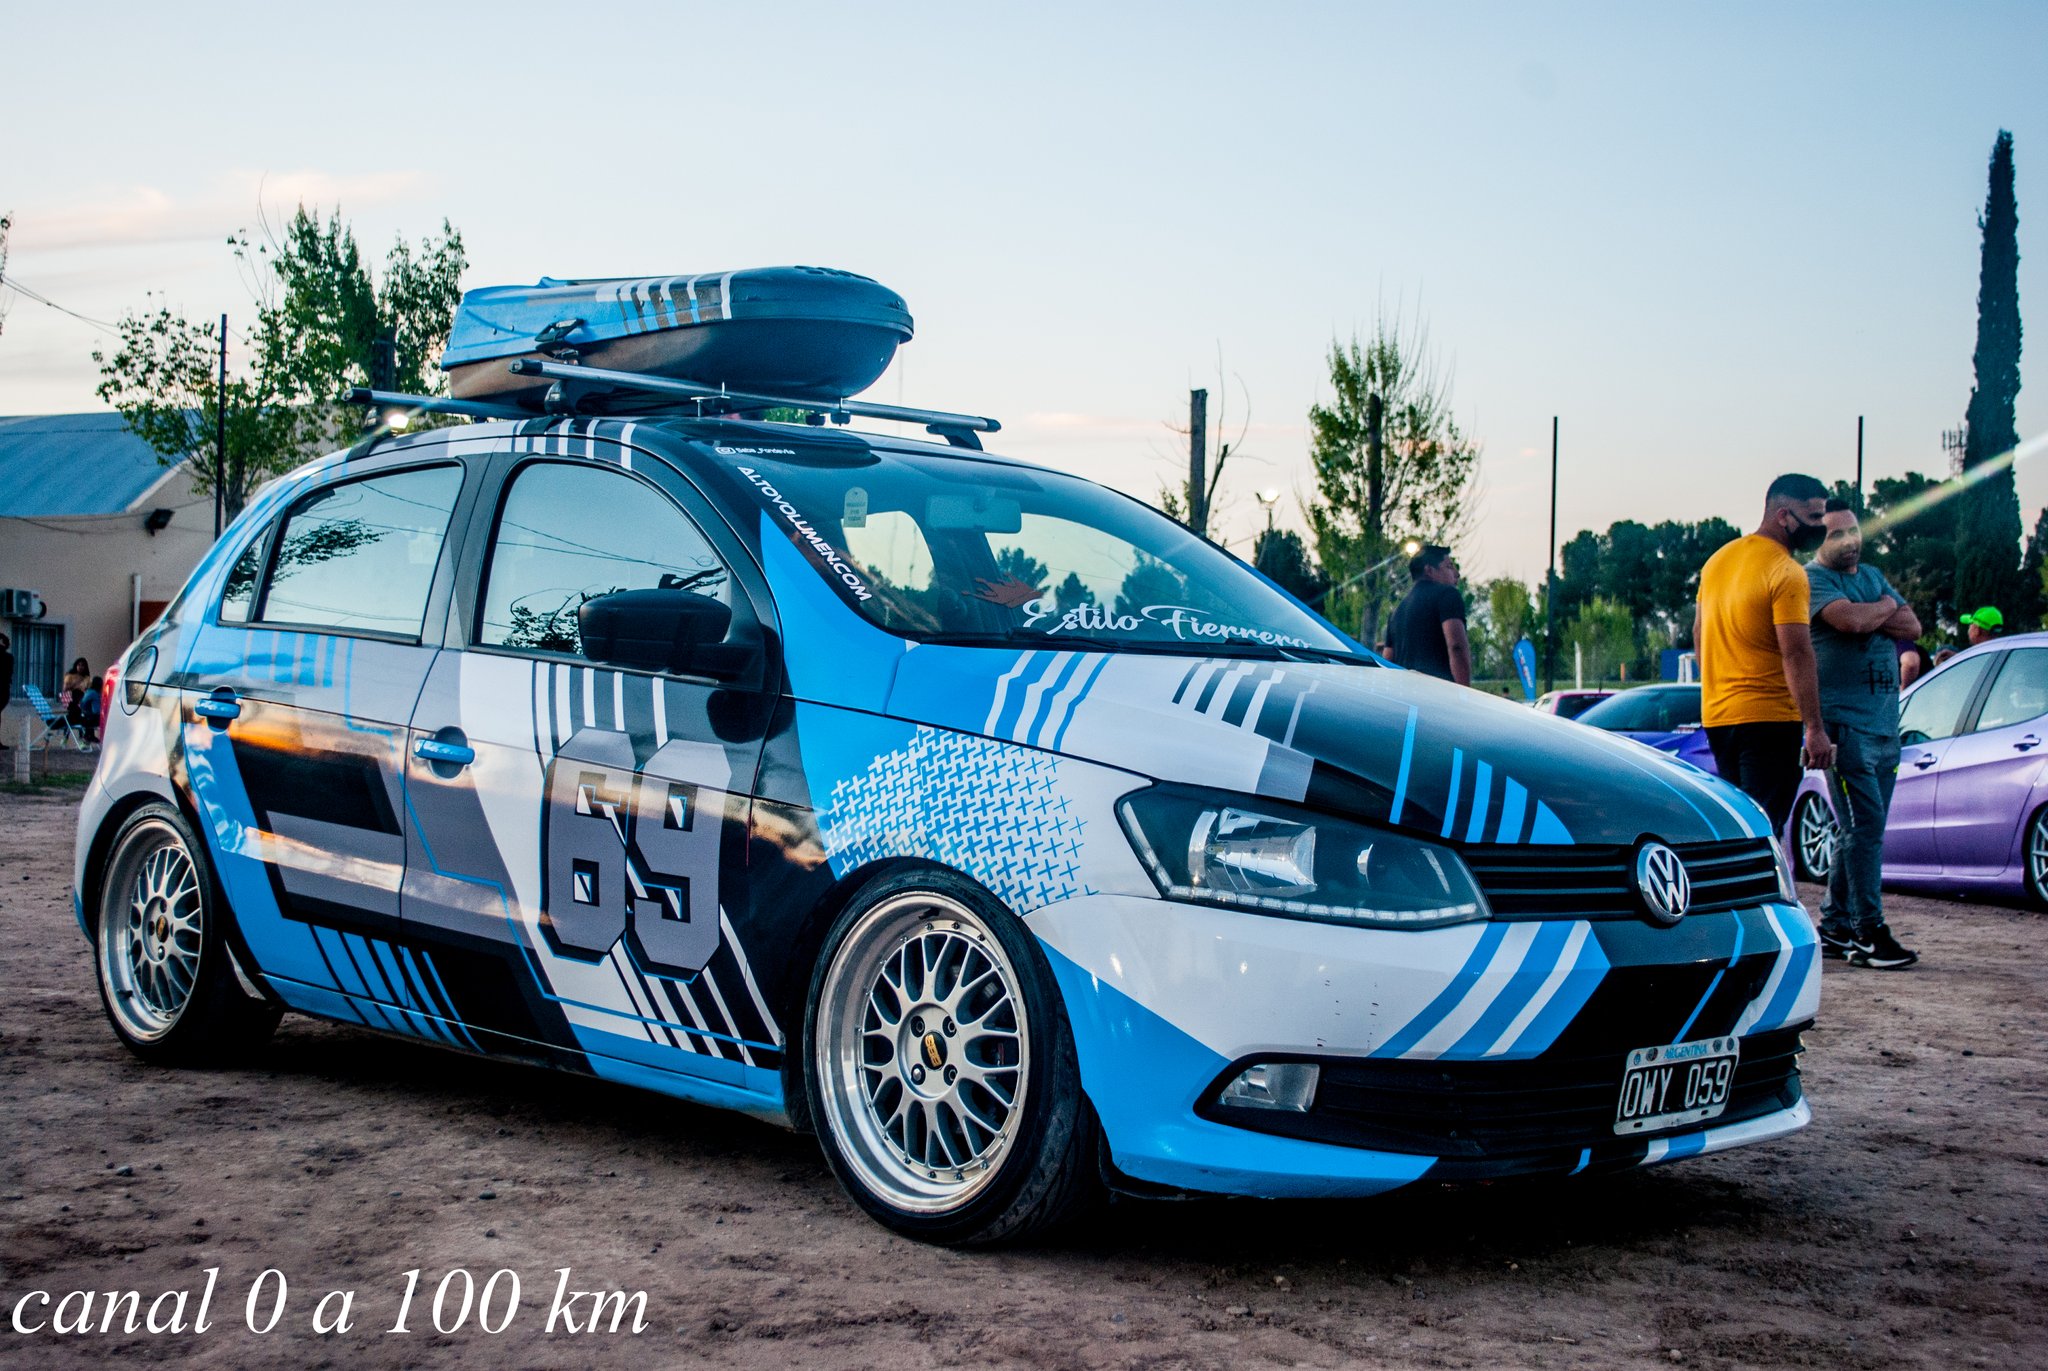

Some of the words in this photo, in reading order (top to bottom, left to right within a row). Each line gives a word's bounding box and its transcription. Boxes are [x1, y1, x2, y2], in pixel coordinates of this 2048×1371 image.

[737, 466, 872, 601] ALTOVOLUMEN.COM
[1022, 598, 1144, 635] Estilo
[545, 727, 732, 972] 69
[1663, 1043, 1707, 1059] ARGENTINA
[1623, 1067, 1673, 1117] OWY
[1684, 1058, 1731, 1108] 059
